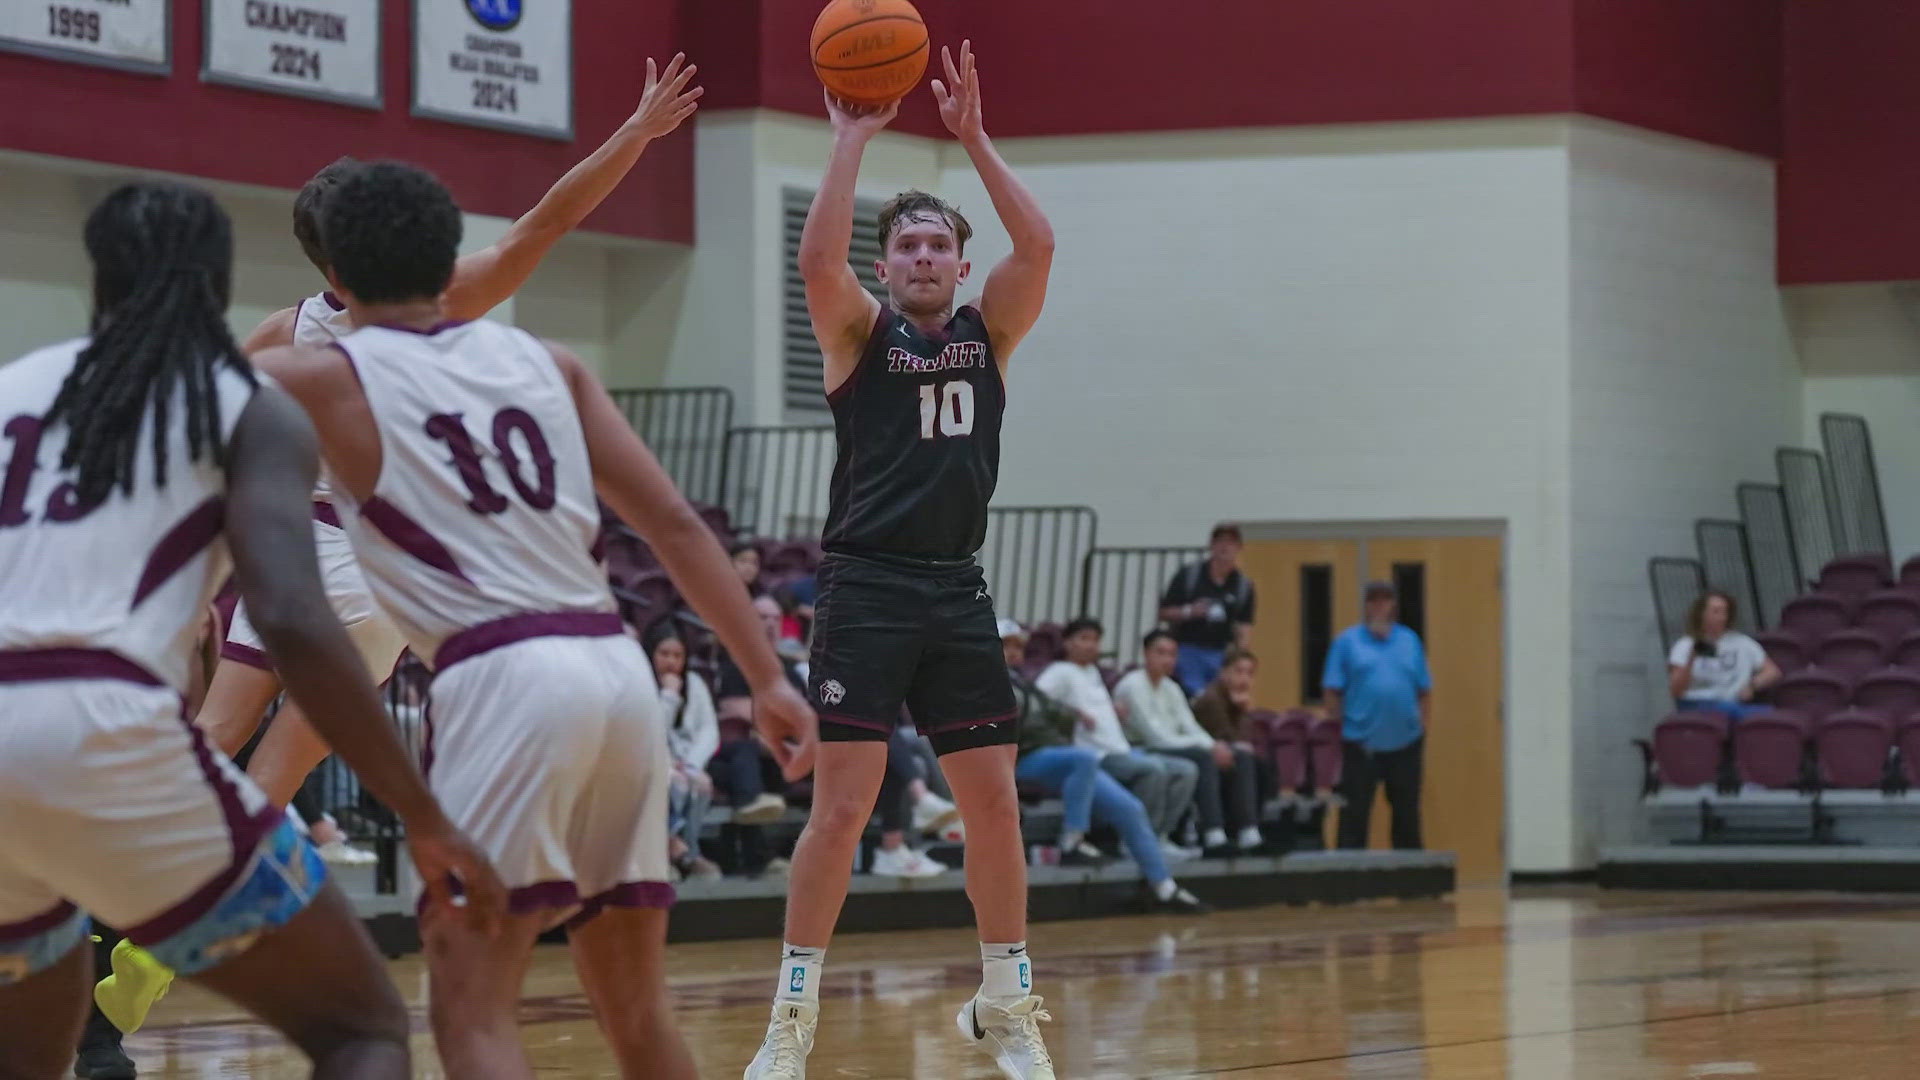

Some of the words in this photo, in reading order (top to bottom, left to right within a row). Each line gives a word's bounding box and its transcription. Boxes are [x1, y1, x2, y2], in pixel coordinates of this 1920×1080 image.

[49, 5, 100, 42] 1999
[246, 0, 347, 42] CHAMPION
[270, 43, 320, 80] 2024
[887, 341, 986, 373] TRINITY
[919, 380, 975, 439] 10
[425, 408, 556, 514] 10
